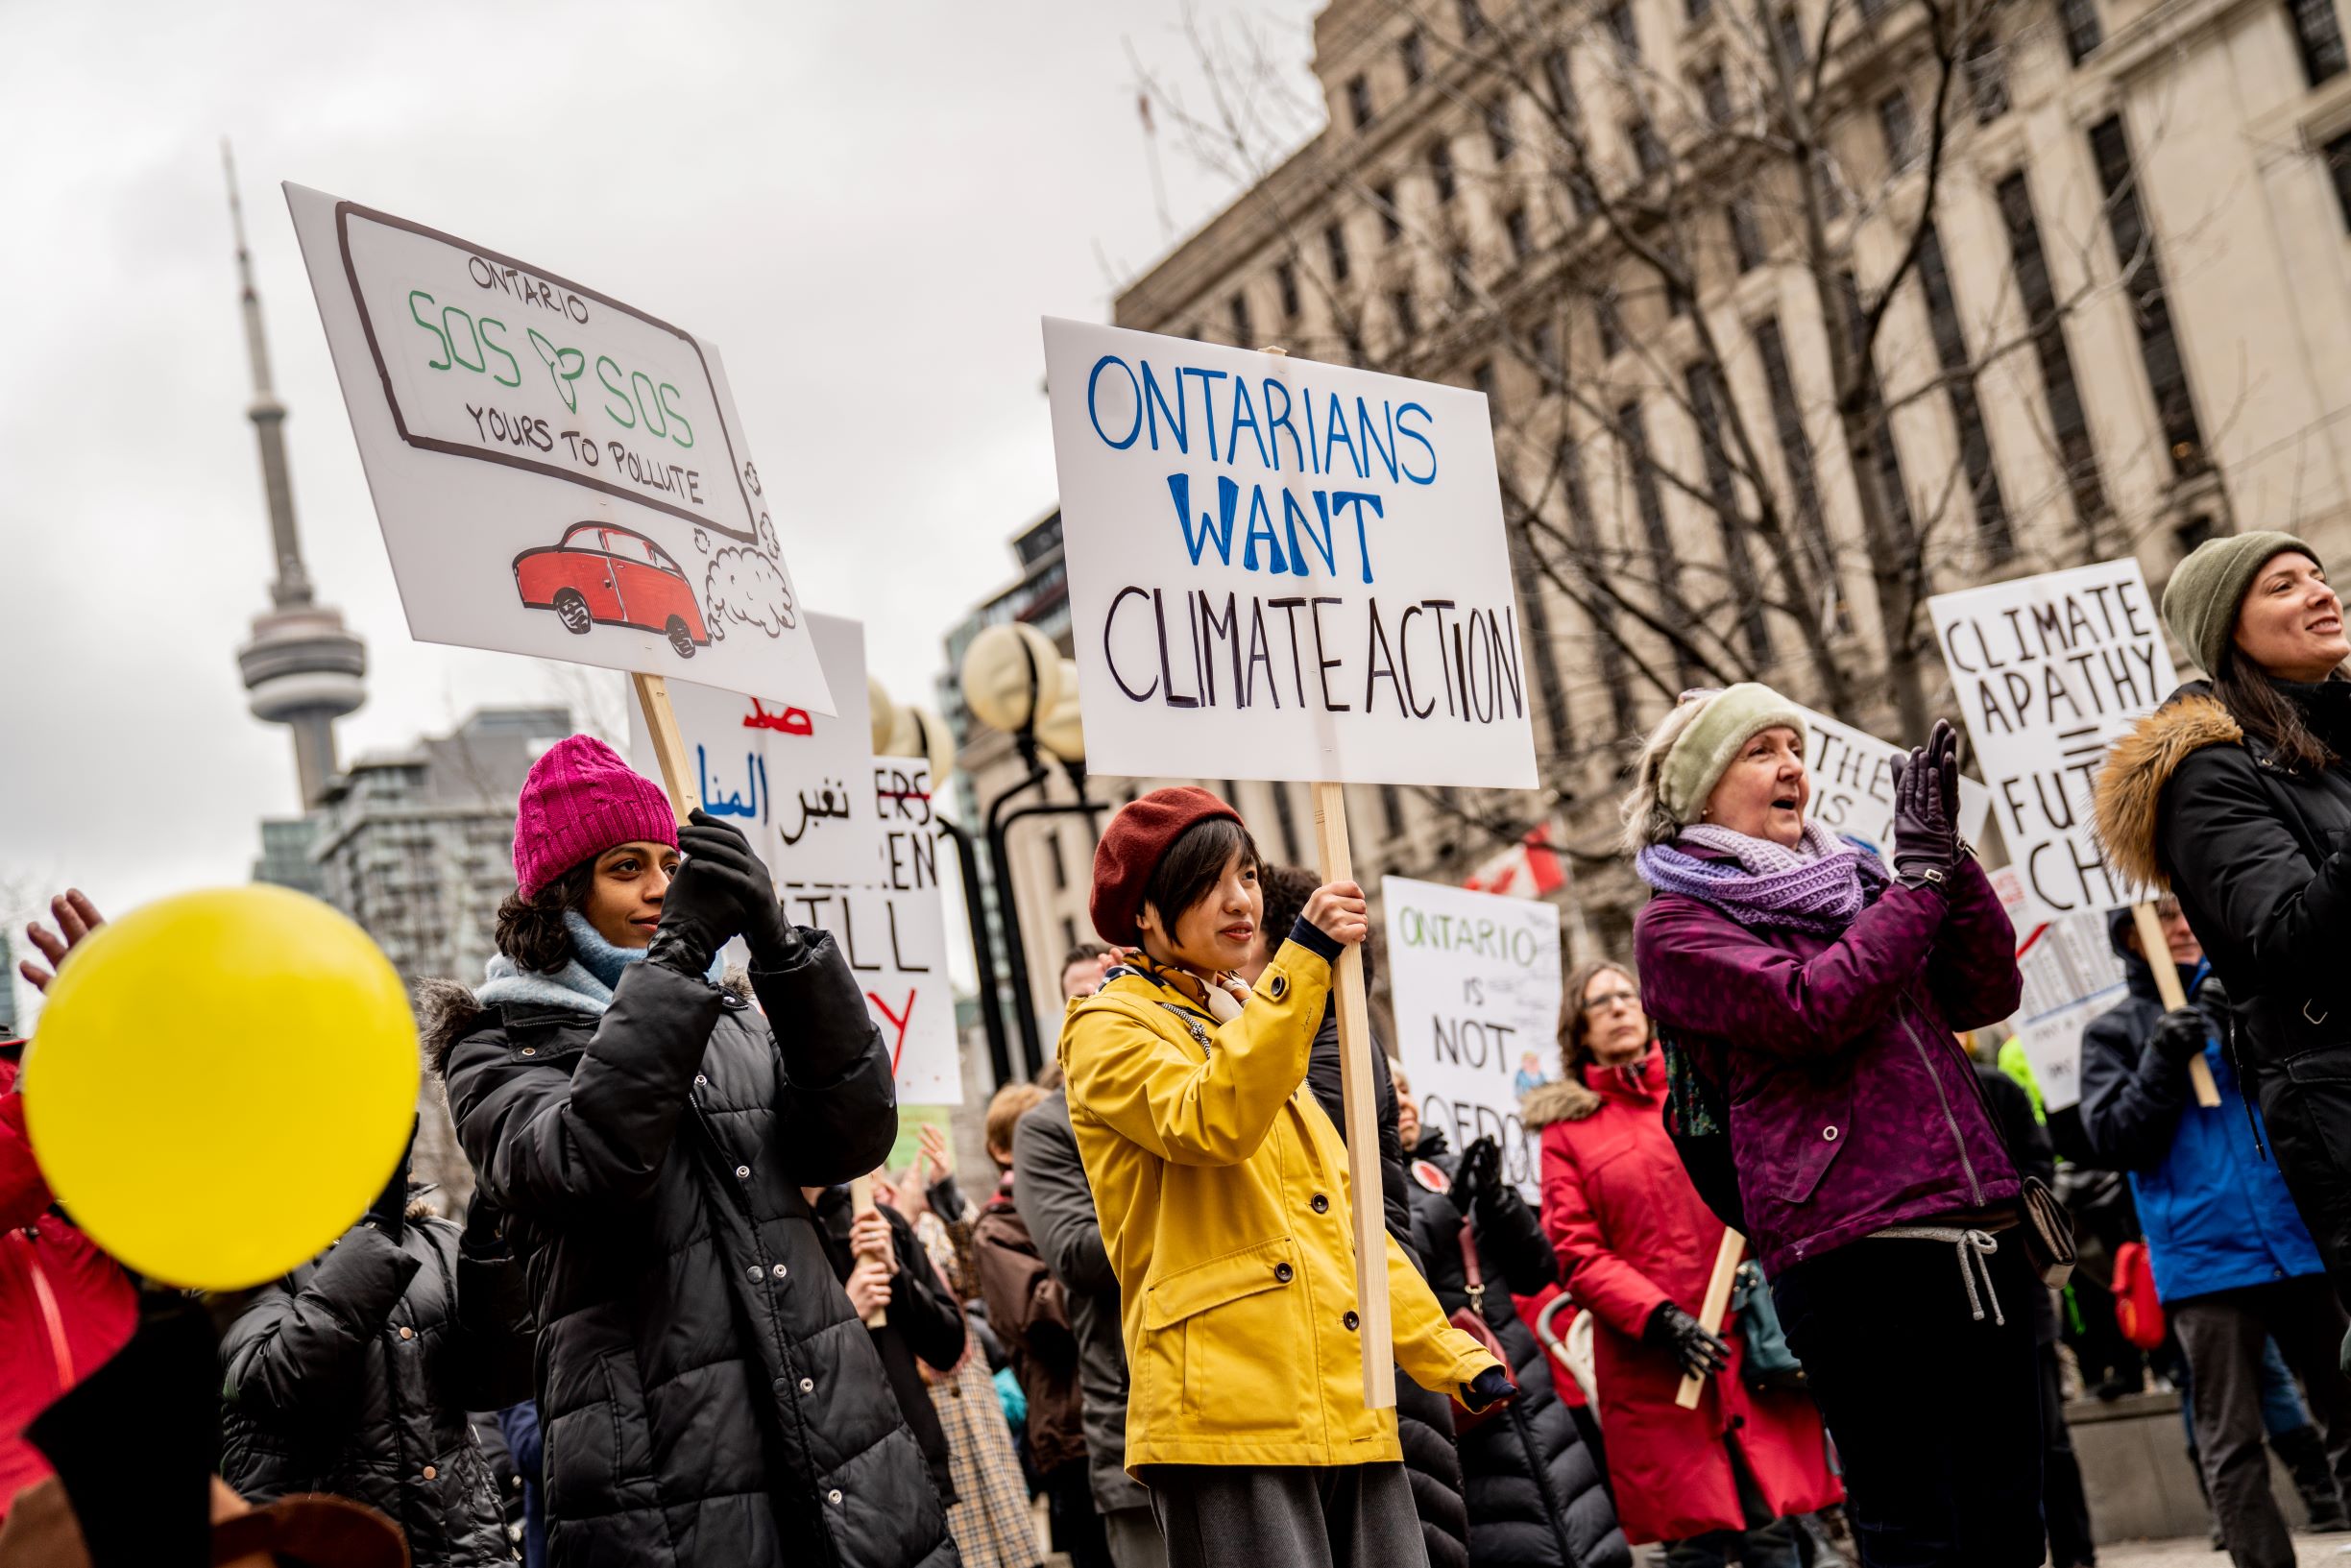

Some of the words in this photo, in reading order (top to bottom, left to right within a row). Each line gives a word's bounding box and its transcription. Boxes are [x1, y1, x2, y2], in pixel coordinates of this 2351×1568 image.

[469, 255, 589, 325] ONTARIO
[408, 290, 521, 387] SOS
[595, 355, 694, 448] SOS
[466, 402, 553, 452] YOURS
[560, 430, 599, 467] TO
[607, 440, 704, 505] POLLUTE
[1087, 354, 1437, 485] ONTARIANS
[1167, 472, 1385, 585] WANT
[1103, 585, 1351, 713] CLIMATE
[1365, 595, 1524, 724] ACTION
[1945, 580, 2151, 674] CLIMATE
[1977, 641, 2159, 734] APATHY
[697, 742, 768, 827] المنا
[874, 768, 931, 827] ERS
[1811, 790, 1854, 827] IS
[2001, 759, 2100, 835] FUT
[885, 831, 939, 891] EN
[1399, 905, 1538, 968] ONTARIO
[1463, 976, 1486, 1007] IS
[1433, 1013, 1515, 1075] NOT
